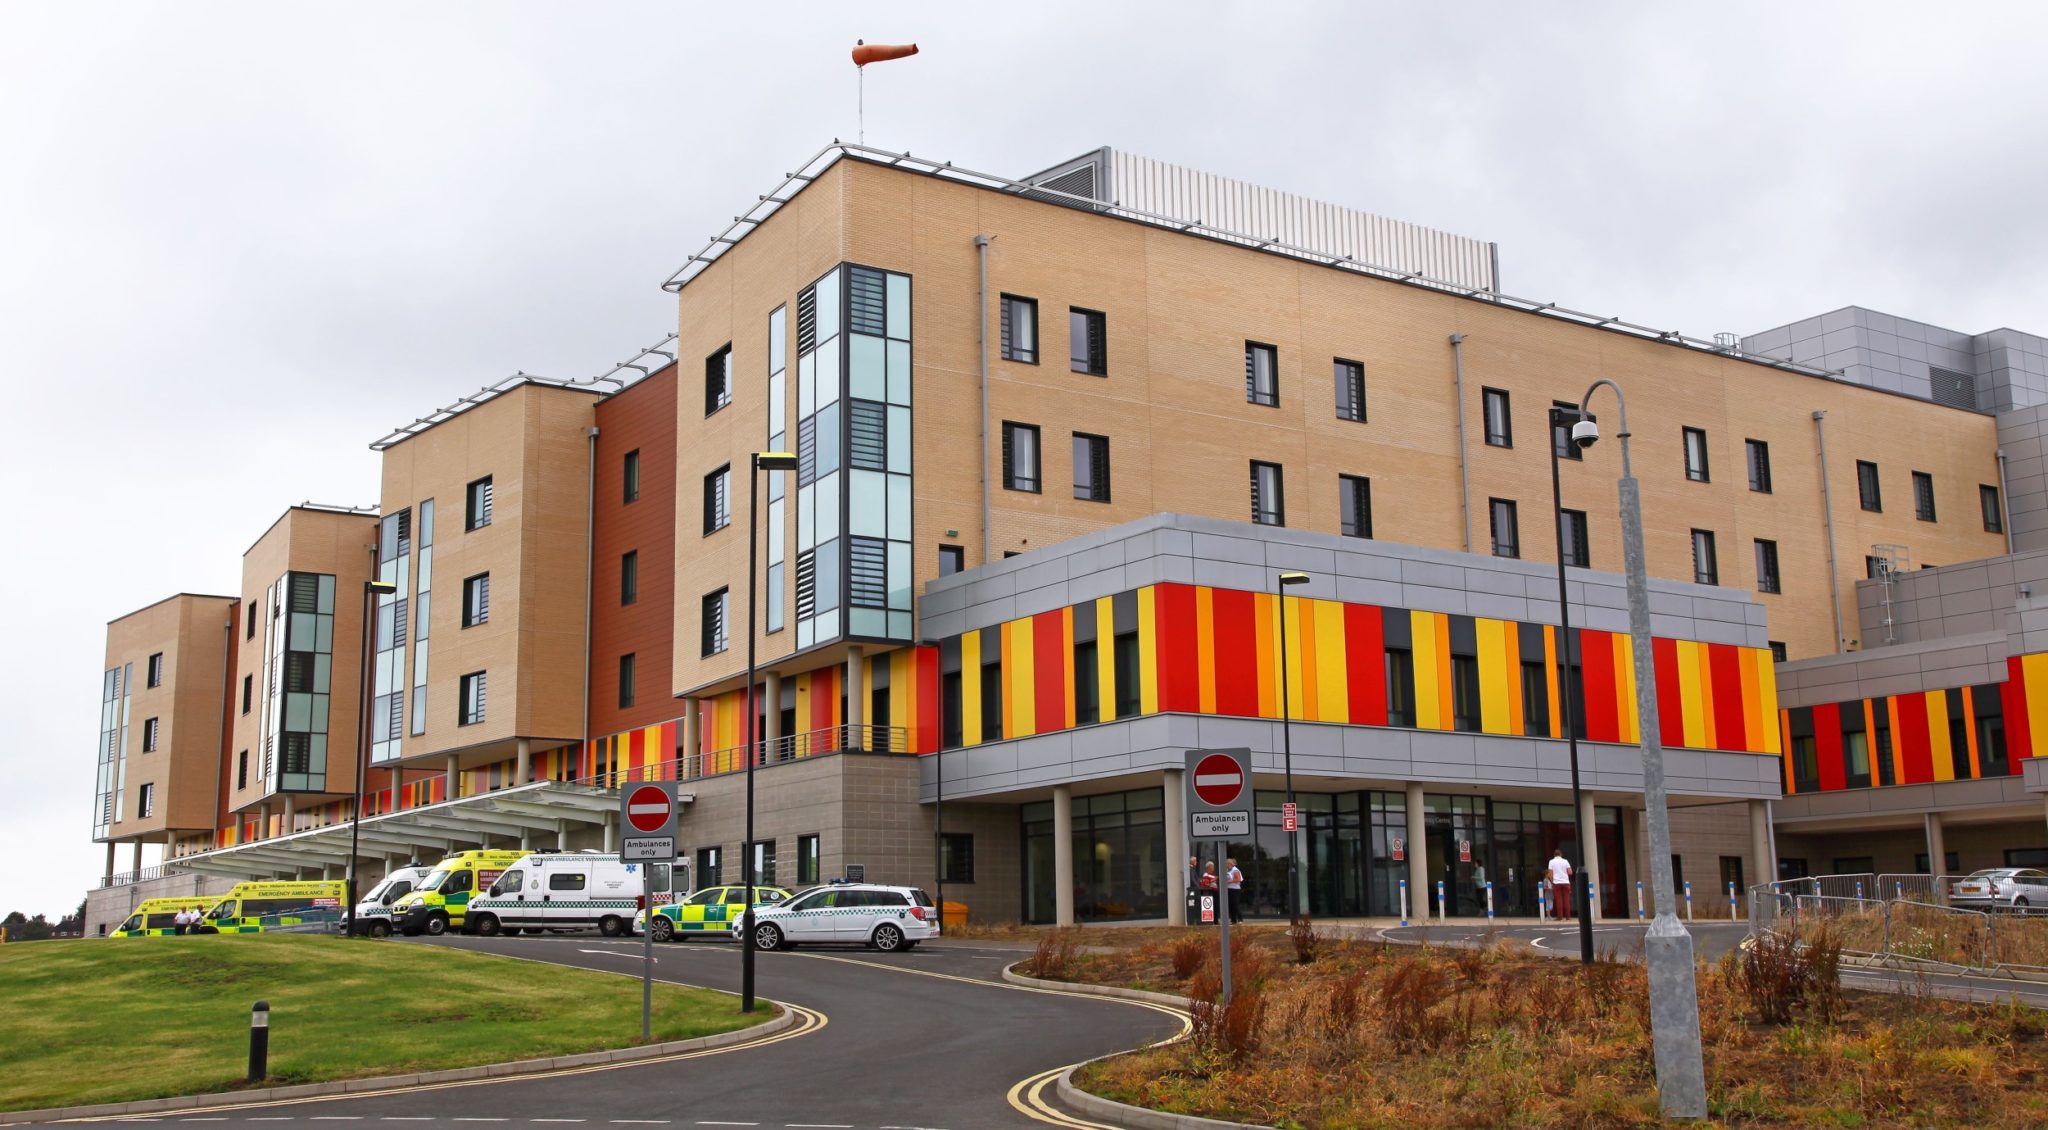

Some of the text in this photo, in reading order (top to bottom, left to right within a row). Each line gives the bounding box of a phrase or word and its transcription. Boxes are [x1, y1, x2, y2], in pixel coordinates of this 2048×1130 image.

[1195, 815, 1246, 823] Ambulances
[1286, 819, 1294, 829] E
[1211, 824, 1230, 833] only
[626, 840, 671, 848] Ambulances
[640, 848, 656, 856] only
